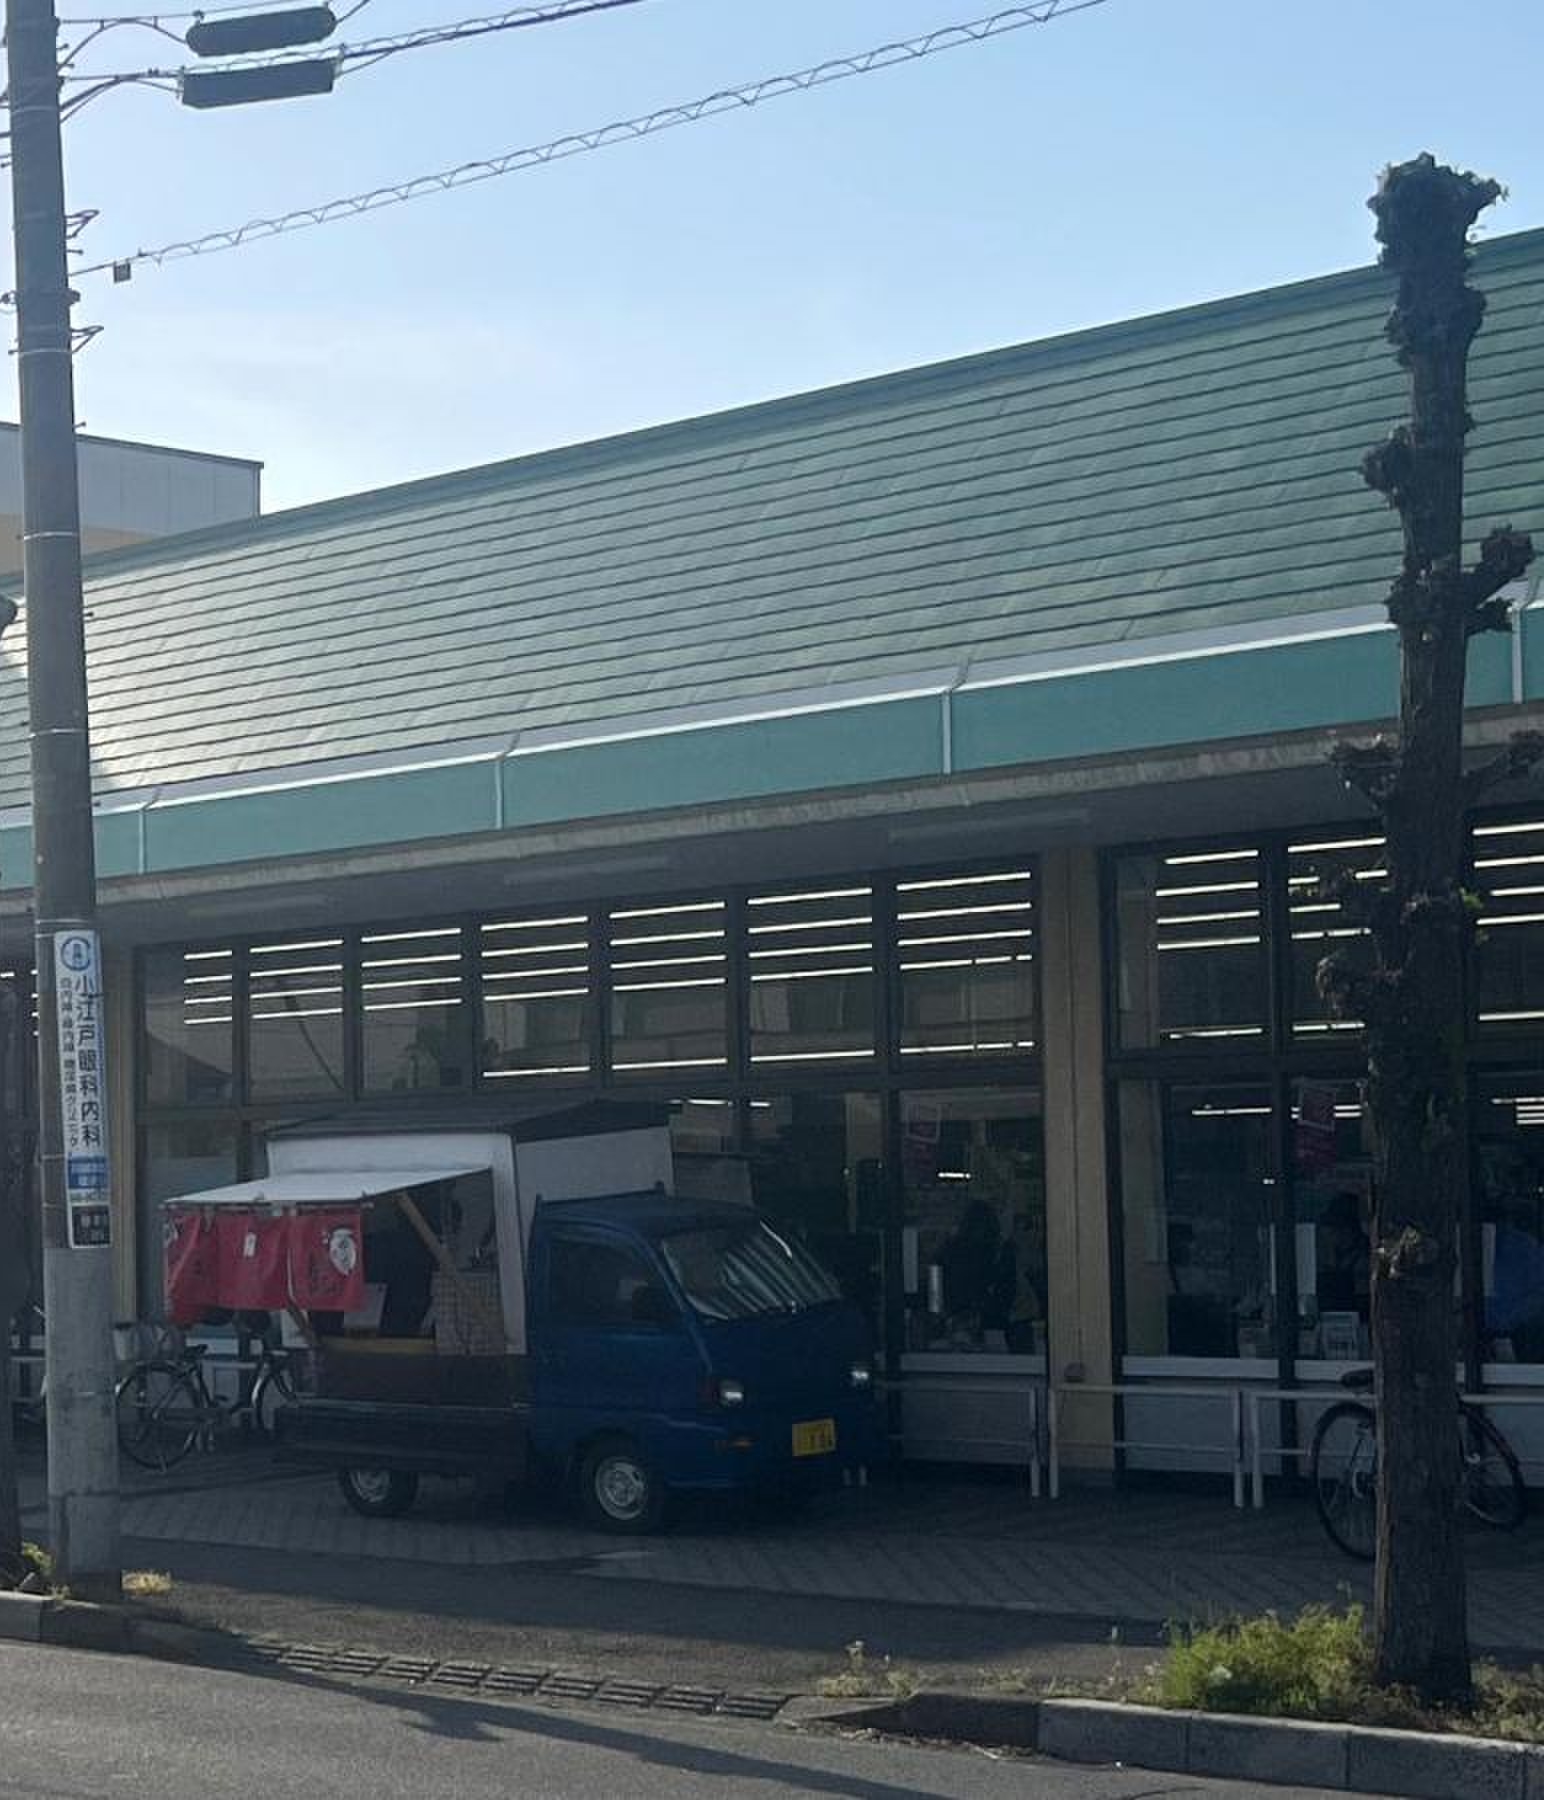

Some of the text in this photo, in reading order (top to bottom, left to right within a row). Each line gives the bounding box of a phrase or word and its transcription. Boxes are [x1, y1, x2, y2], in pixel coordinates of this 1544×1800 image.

[75, 975, 101, 1147] 小江戸眼科内科
